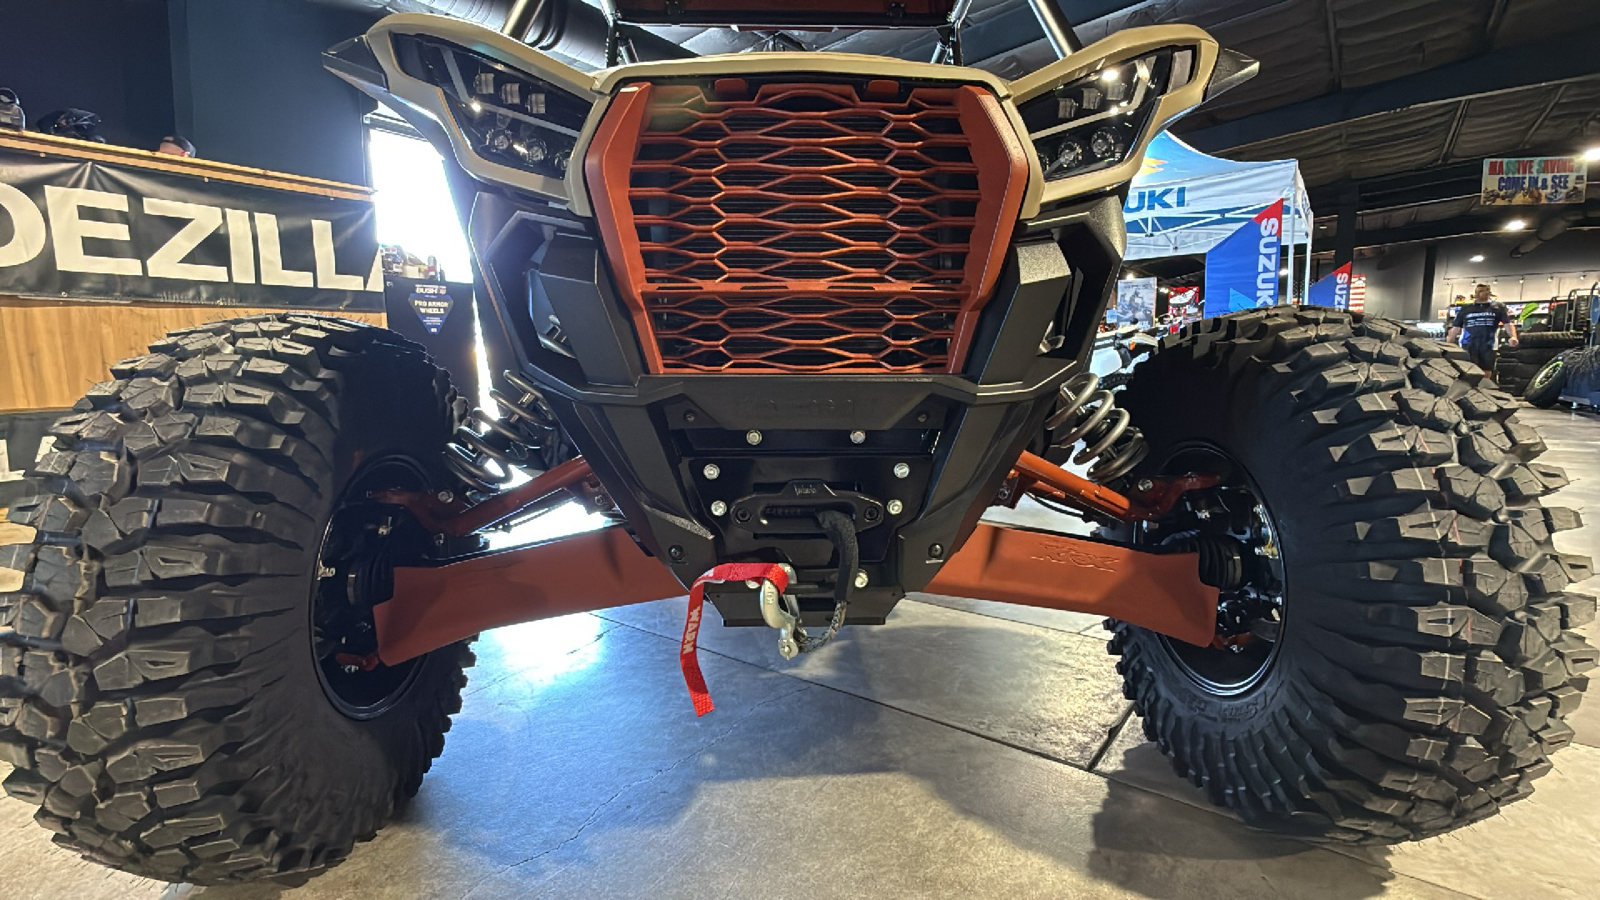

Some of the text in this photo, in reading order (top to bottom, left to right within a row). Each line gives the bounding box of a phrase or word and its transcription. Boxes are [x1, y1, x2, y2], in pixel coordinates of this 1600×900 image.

[1488, 160, 1534, 176] MASSIVE
[1498, 176, 1525, 191] COME
[1528, 175, 1540, 191] IN
[1551, 174, 1569, 189] SEE
[1123, 186, 1186, 213] UKI
[1334, 272, 1349, 312] SUZ
